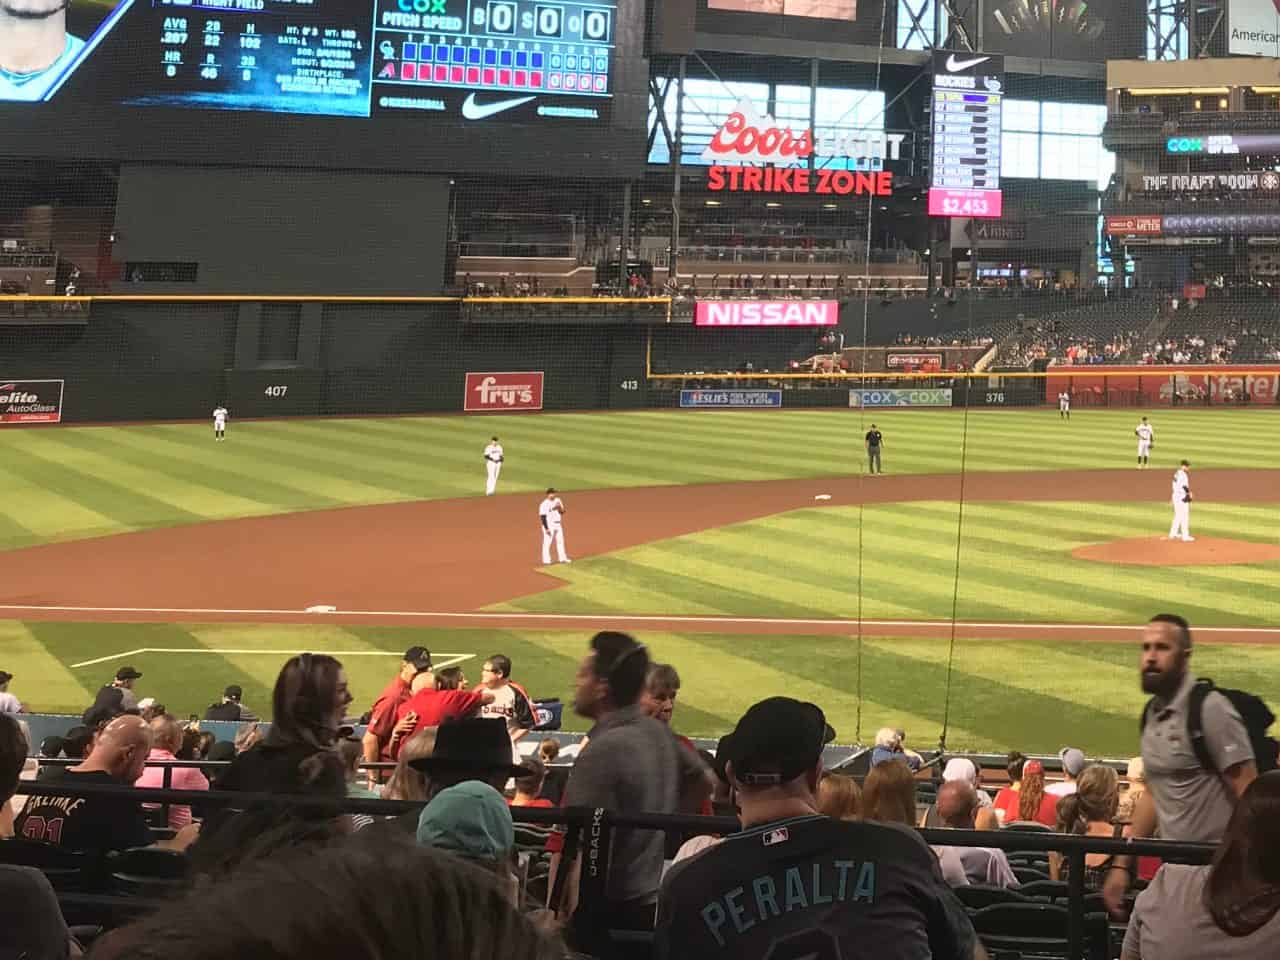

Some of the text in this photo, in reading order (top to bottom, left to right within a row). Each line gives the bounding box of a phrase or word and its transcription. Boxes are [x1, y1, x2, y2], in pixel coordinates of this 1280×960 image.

[163, 17, 187, 30] AVG
[382, 13, 463, 31] PITCH SPEED
[473, 8, 486, 25] B
[492, 4, 512, 30] 0
[521, 13, 534, 29] S
[539, 9, 558, 35] 0
[587, 12, 605, 38] 0
[164, 50, 216, 64] HR R
[709, 111, 815, 158] Coors
[707, 165, 893, 196] STRIKE ZONE
[1142, 175, 1169, 191] THE
[1172, 174, 1216, 190] DRAFT
[706, 302, 828, 325] NISSAN
[264, 385, 288, 397] 407
[474, 376, 533, 405] fry's
[620, 380, 638, 391] 413
[862, 388, 939, 404] COX COX
[6, 403, 57, 413] AutoGlass
[703, 860, 875, 947] PERALTA
